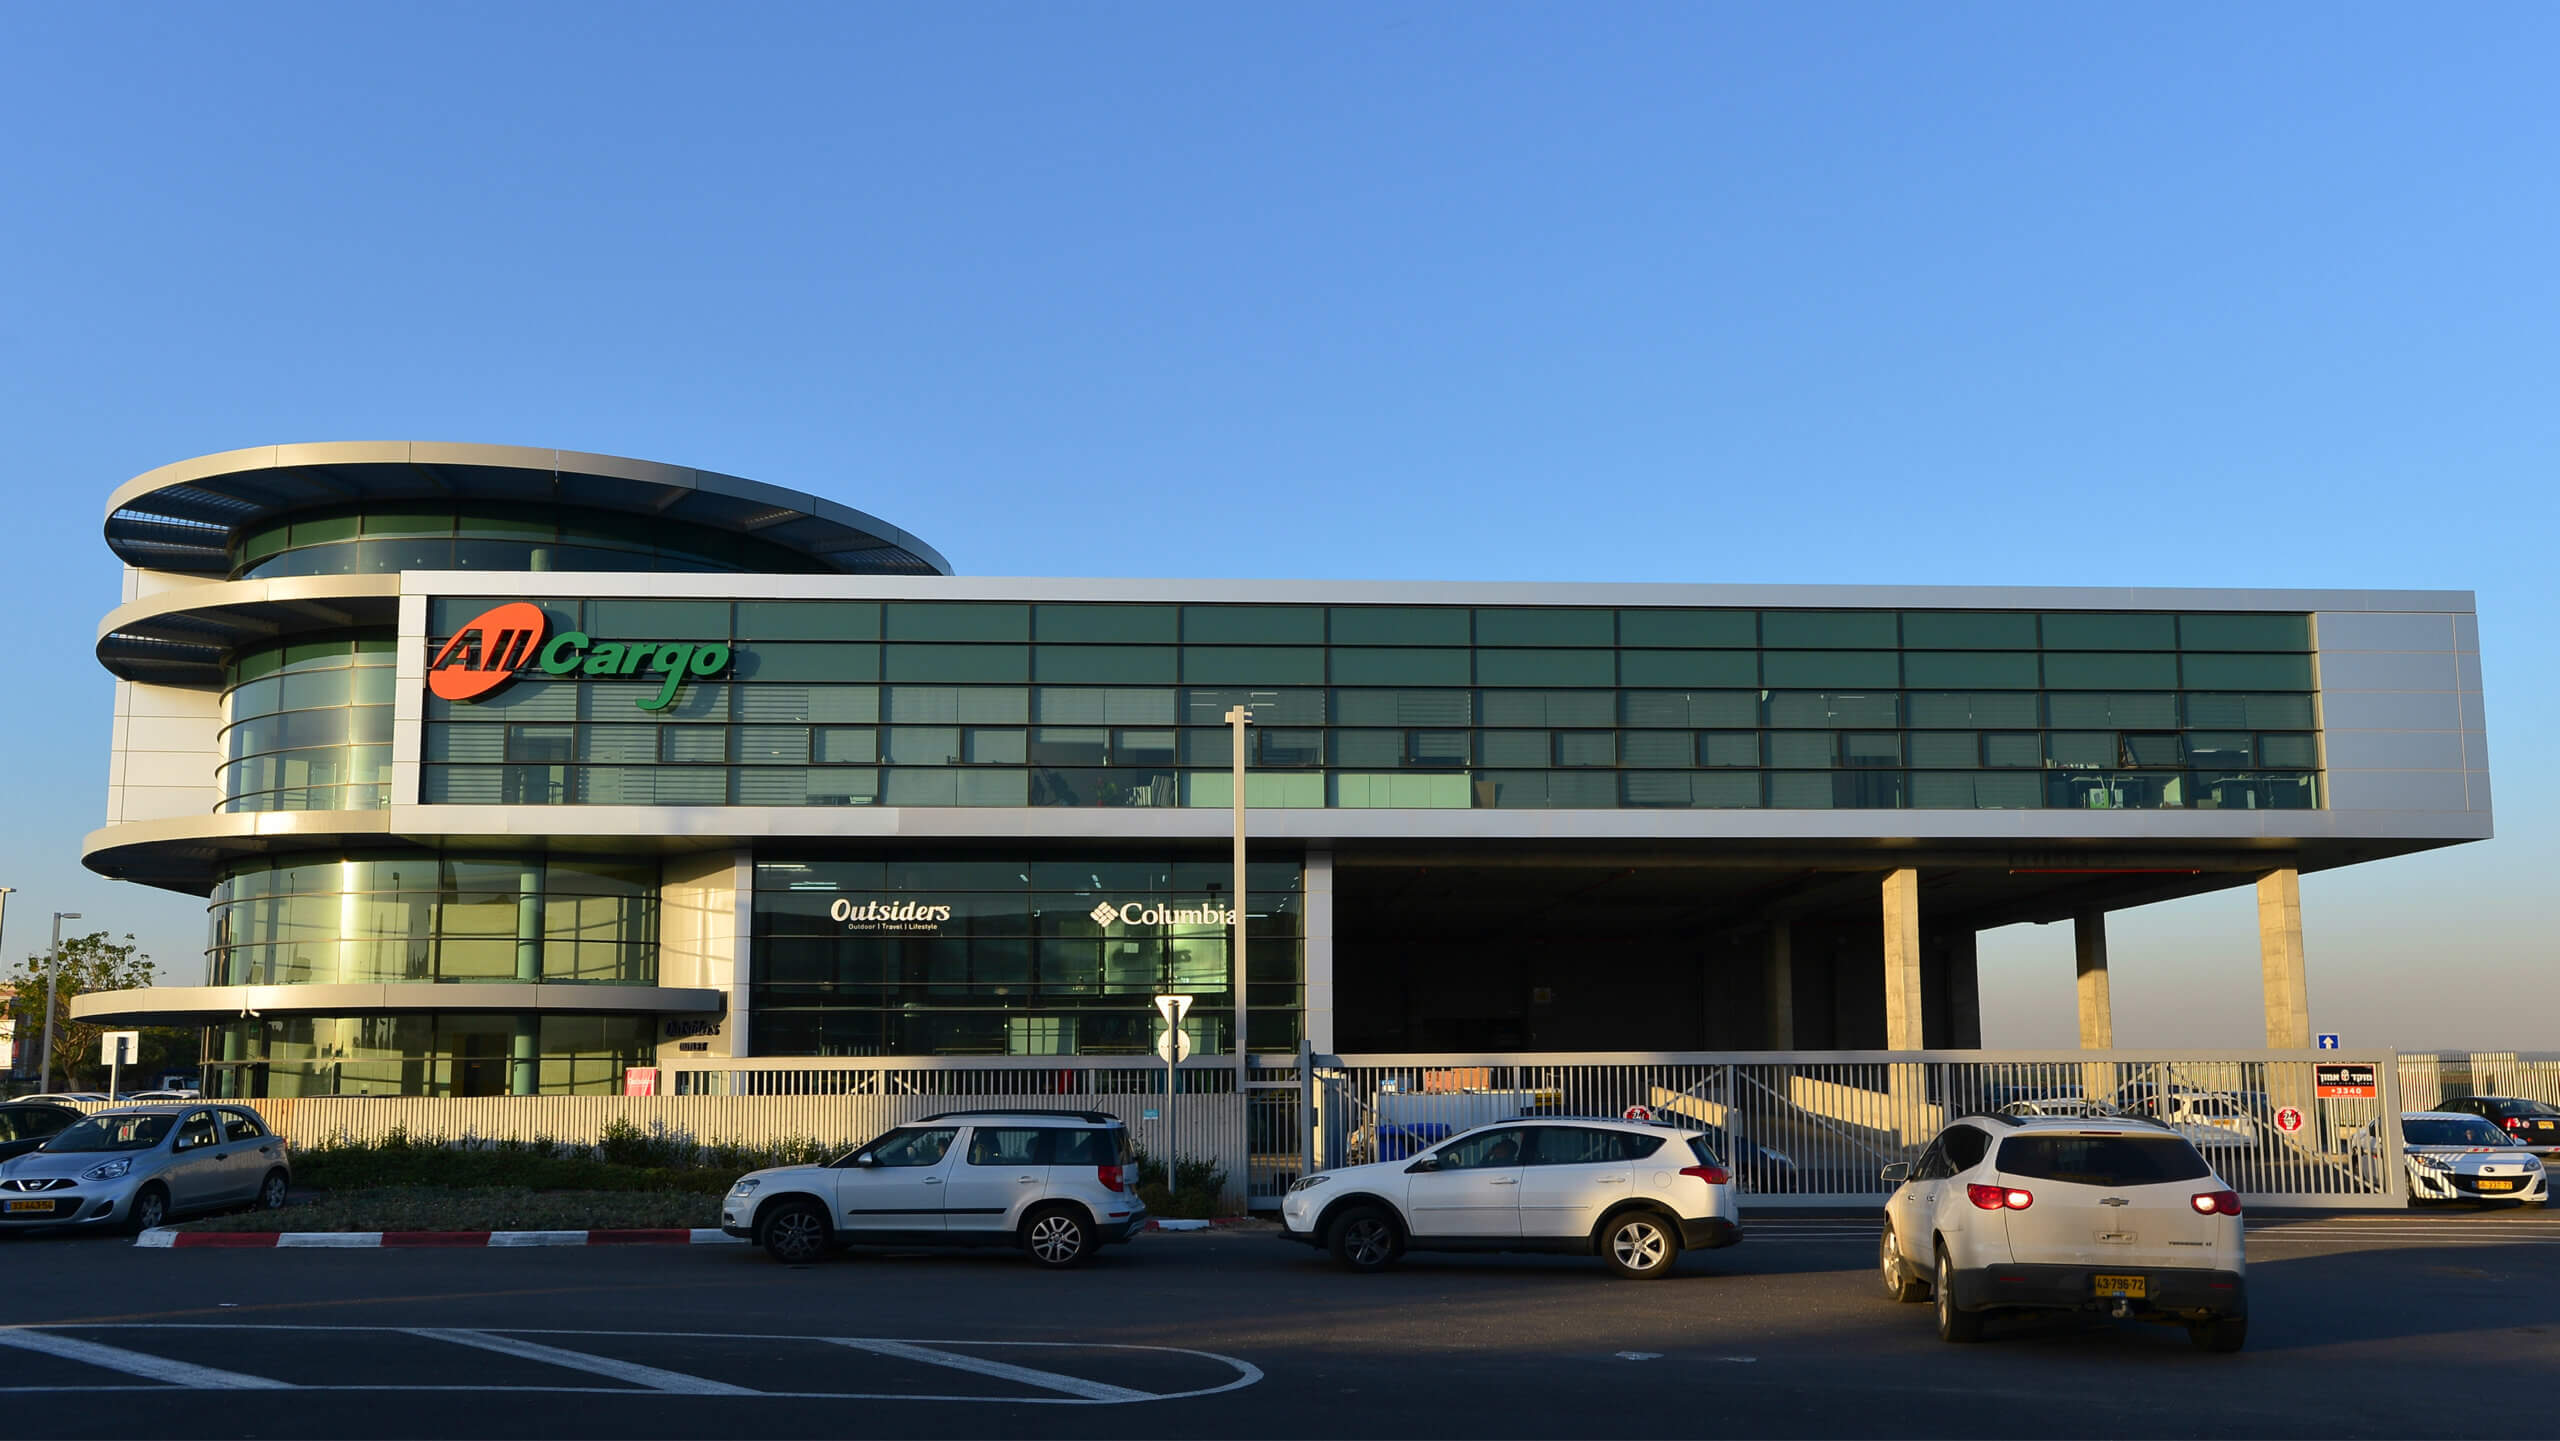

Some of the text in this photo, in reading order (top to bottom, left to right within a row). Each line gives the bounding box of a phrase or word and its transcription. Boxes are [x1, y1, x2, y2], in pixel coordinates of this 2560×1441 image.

[432, 629, 730, 711] All Cargo
[830, 898, 951, 922] Outsiders
[1119, 902, 1237, 926] Columbia
[882, 922, 903, 930] Travel
[908, 923, 938, 931] Lifestyle
